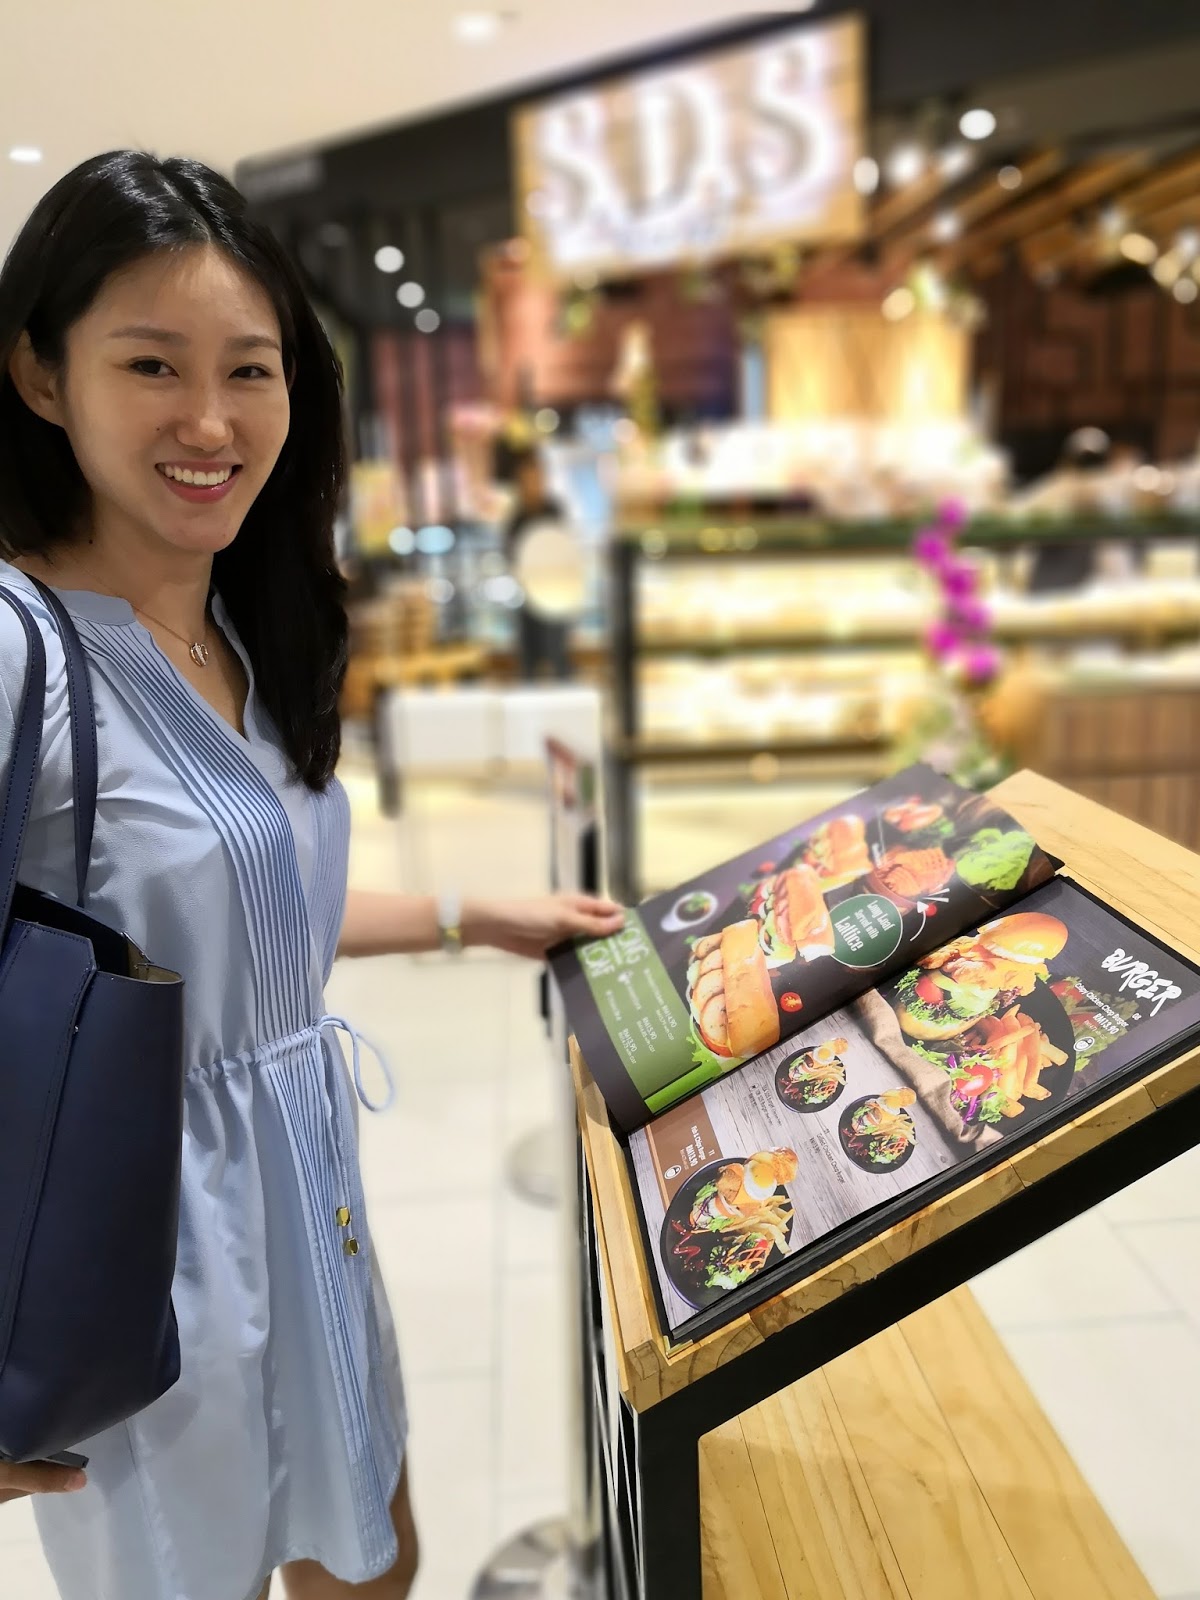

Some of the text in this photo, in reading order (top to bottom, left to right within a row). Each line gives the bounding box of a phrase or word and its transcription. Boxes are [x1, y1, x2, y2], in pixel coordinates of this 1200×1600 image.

[854, 908, 880, 939] Served with
[866, 900, 896, 931] Long Loaf
[834, 915, 864, 952] Lattice
[1101, 948, 1182, 1017] BURGER
[1086, 991, 1104, 1007] Chicken
[1101, 1004, 1115, 1017] Chop
[1112, 1013, 1129, 1028] Burger
[1092, 1013, 1119, 1035] RM13.90
